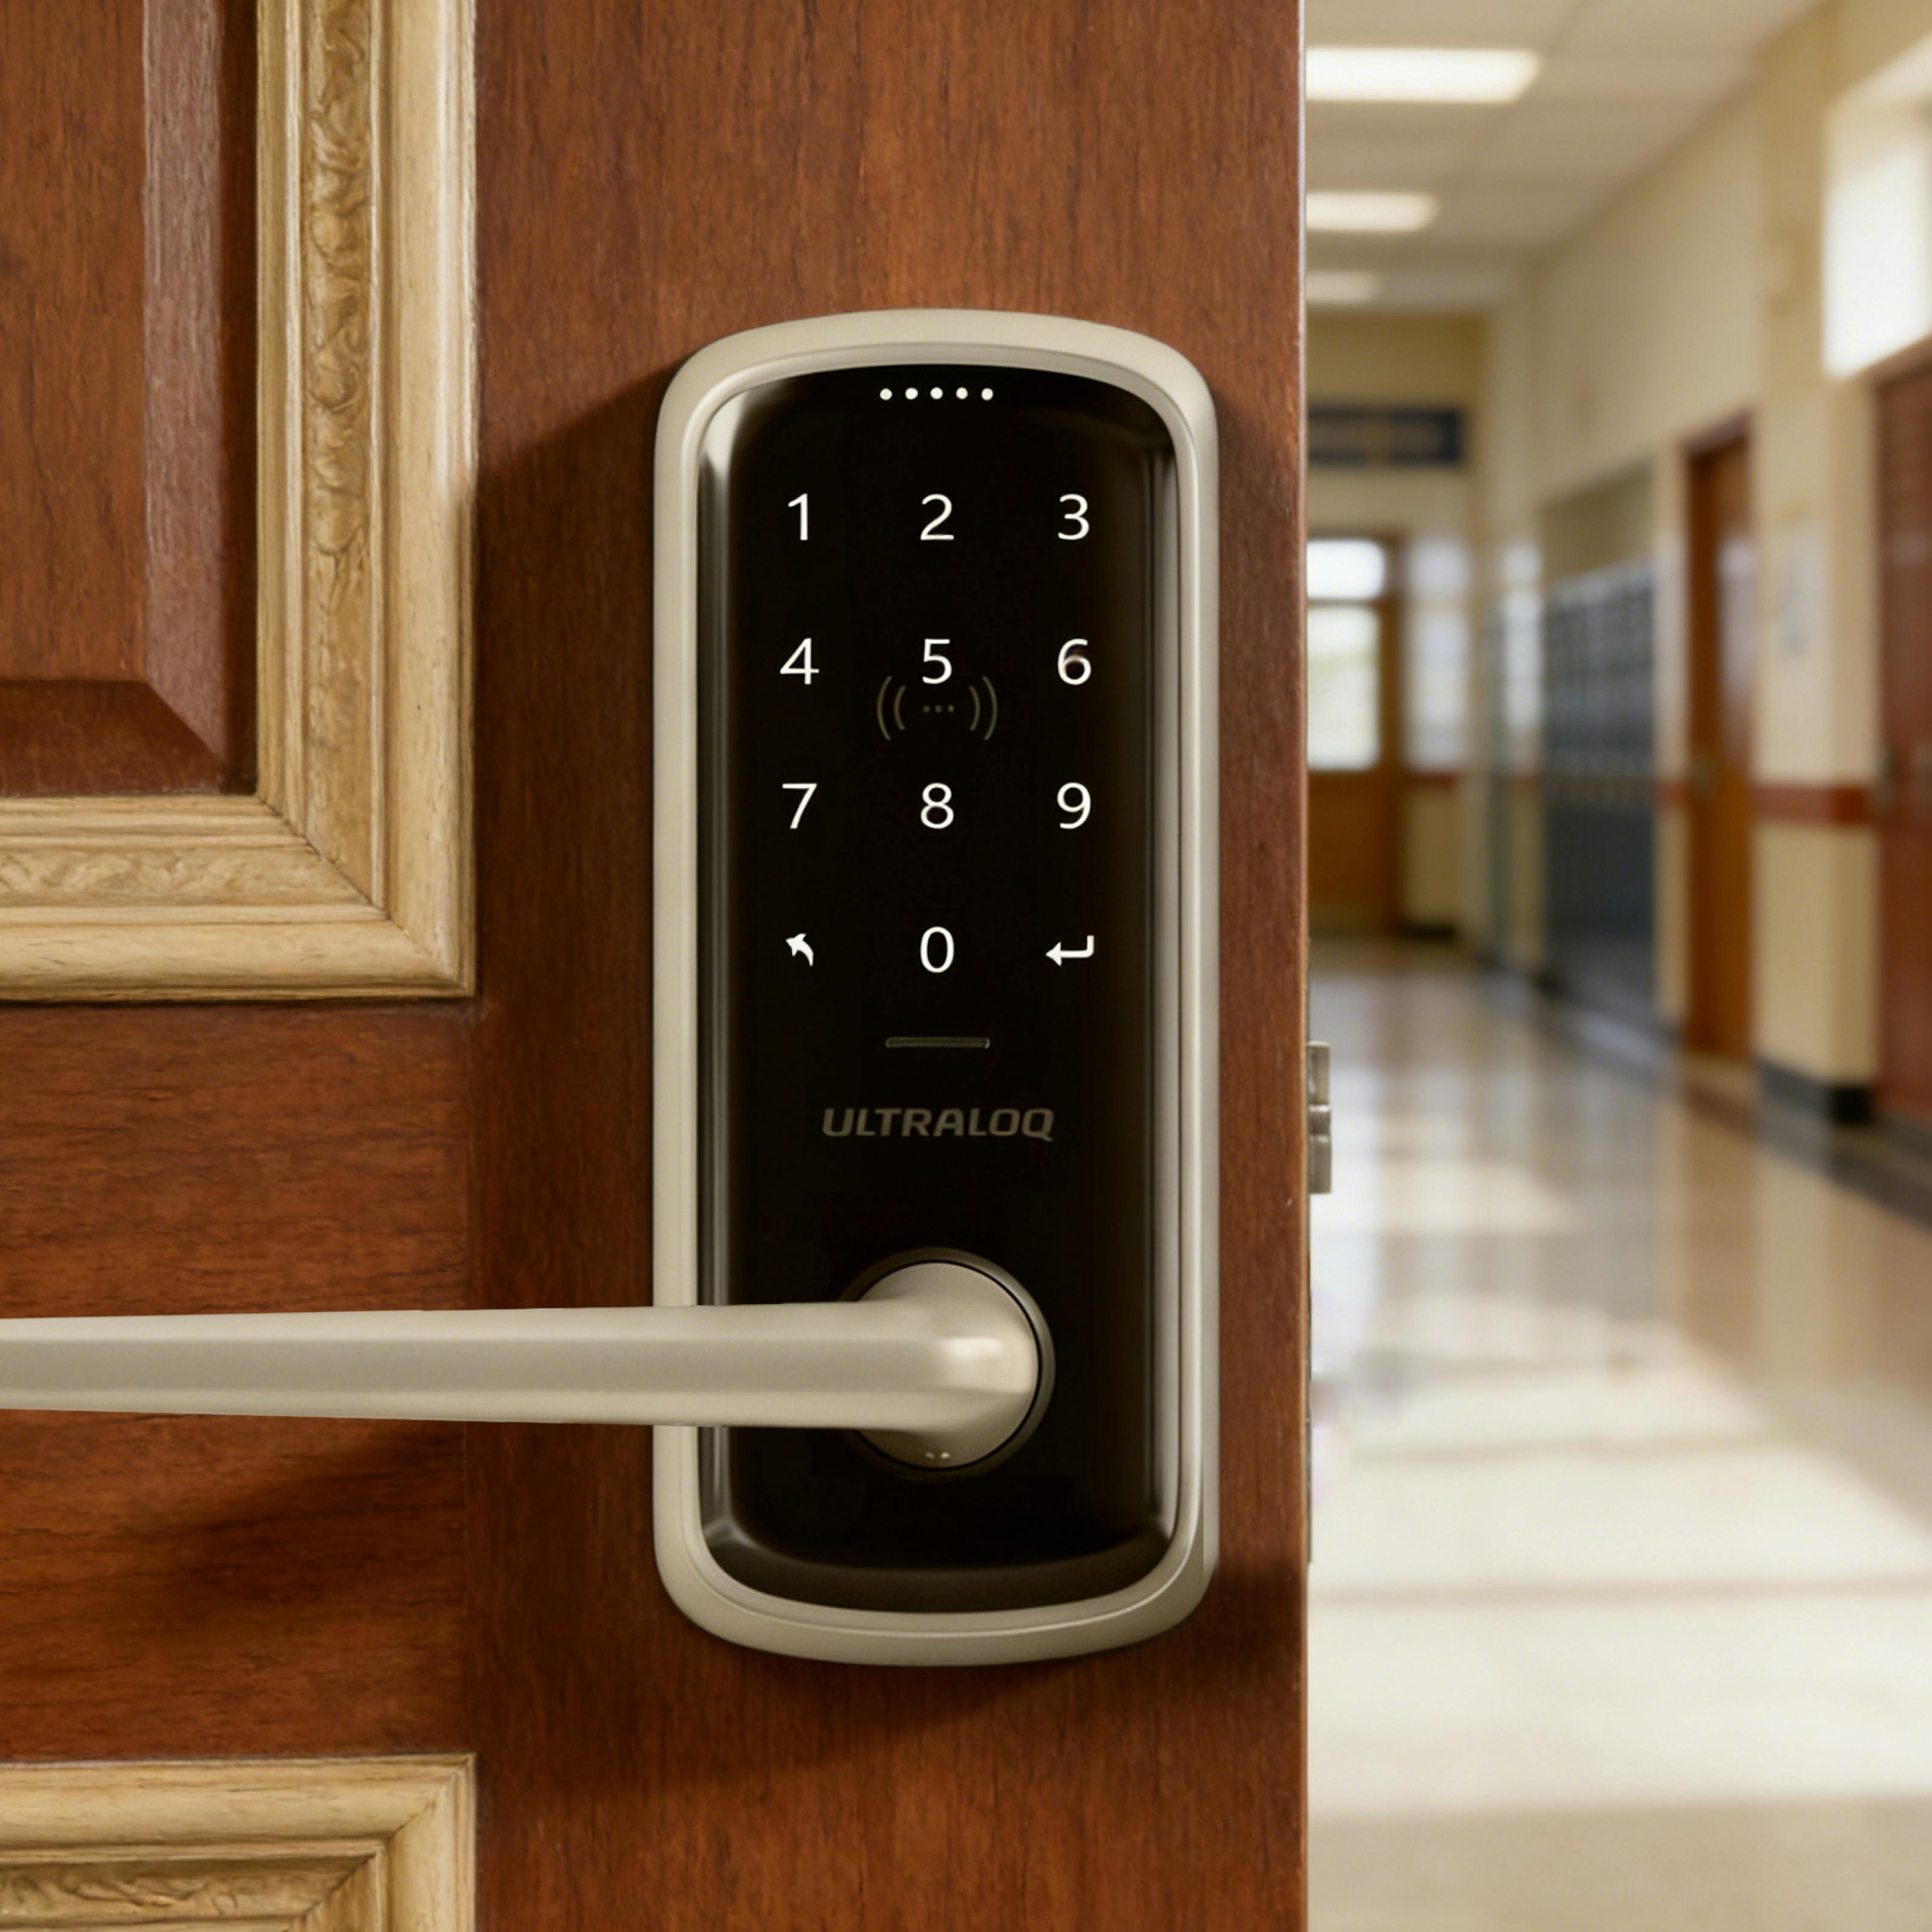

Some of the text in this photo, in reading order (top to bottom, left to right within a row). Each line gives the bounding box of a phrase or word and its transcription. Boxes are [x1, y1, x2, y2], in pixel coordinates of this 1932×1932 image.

[787, 493, 1090, 541] 1 2 3
[779, 638, 1092, 686] 4 5 6
[781, 782, 1092, 830] 7 8 9
[920, 926, 955, 974] 0
[822, 1108, 1054, 1142] ULTRALOQ
